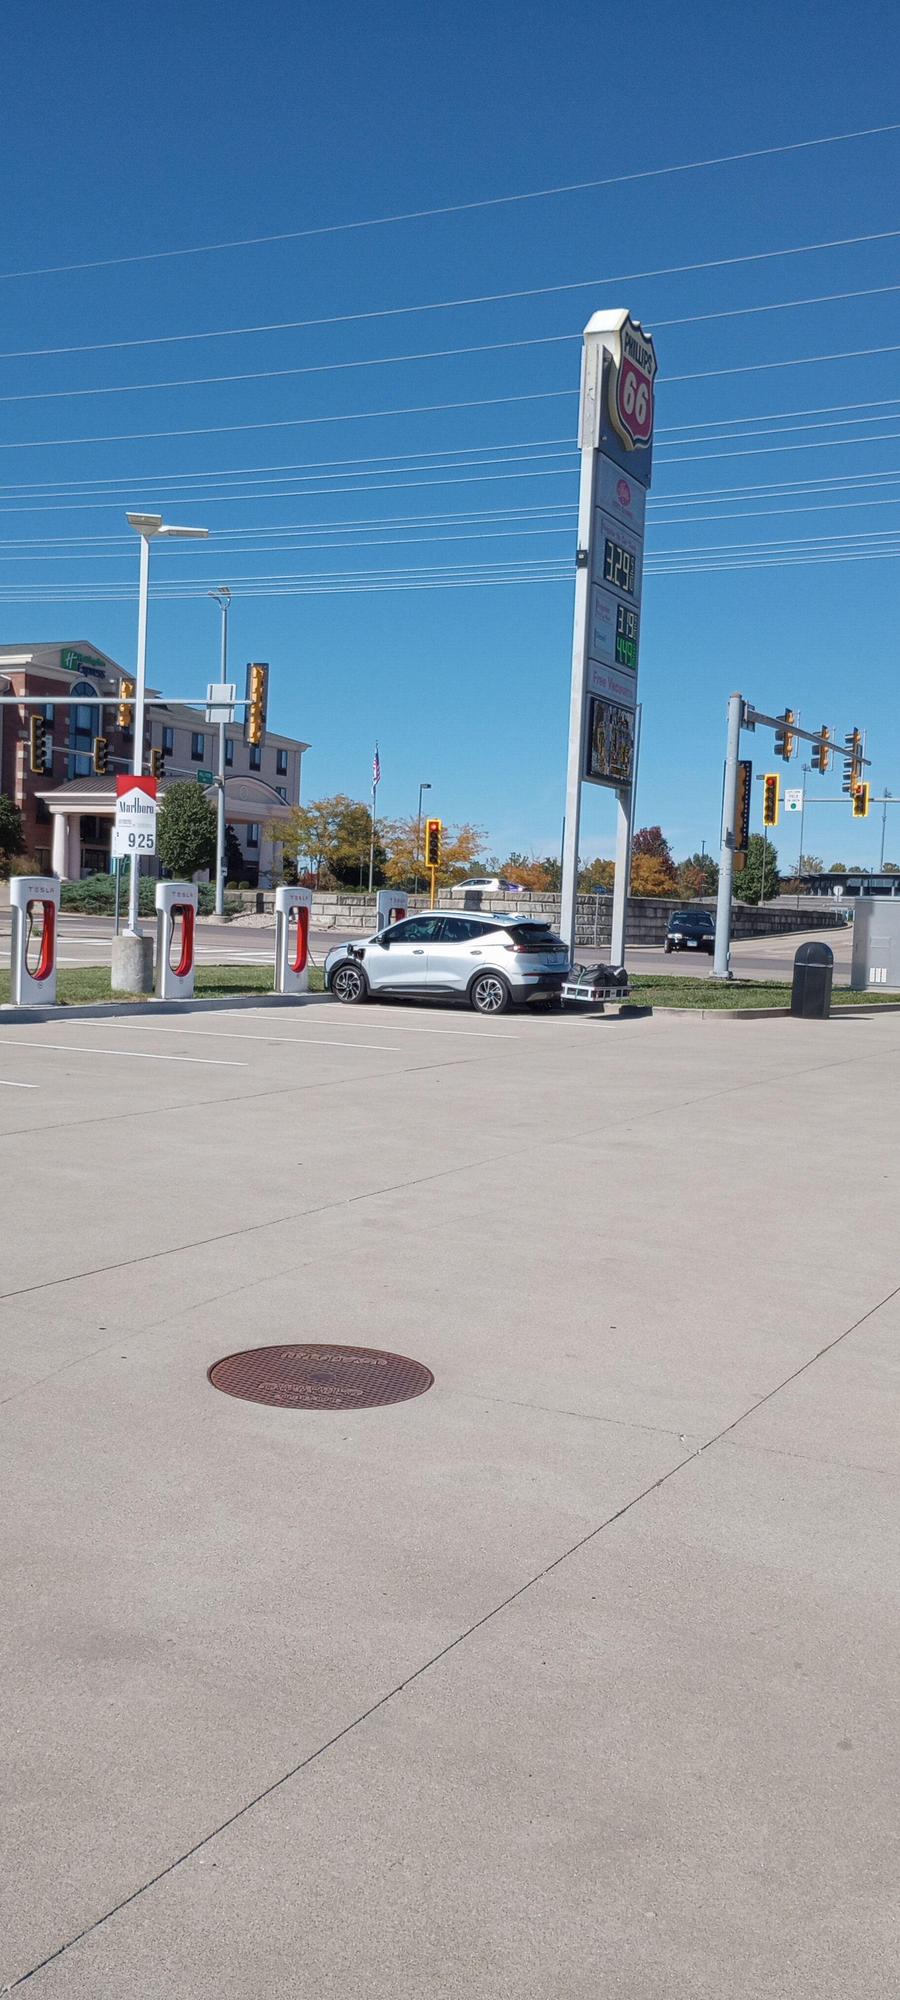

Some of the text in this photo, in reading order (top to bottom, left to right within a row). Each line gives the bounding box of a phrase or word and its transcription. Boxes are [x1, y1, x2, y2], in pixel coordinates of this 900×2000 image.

[623, 332, 653, 374] PHILLIPS
[623, 371, 650, 425] 66
[119, 797, 154, 814] Marlboro
[28, 886, 55, 895] TESLA
